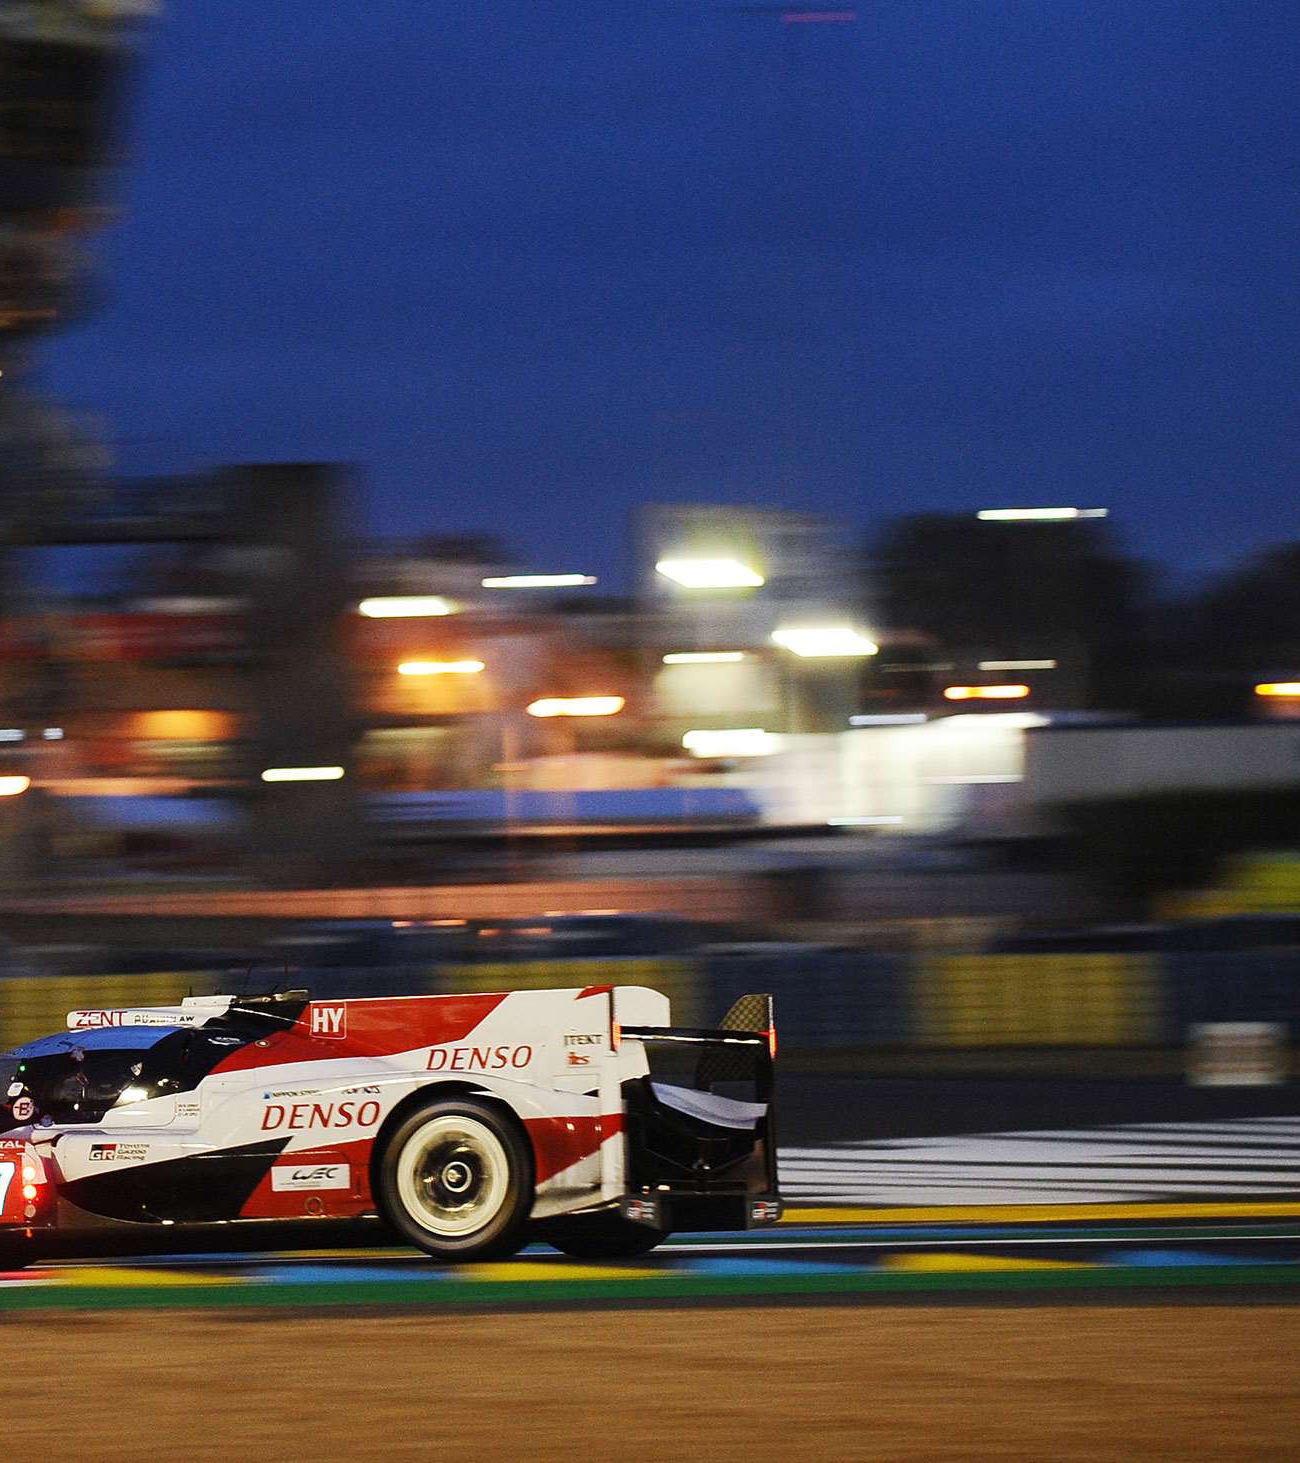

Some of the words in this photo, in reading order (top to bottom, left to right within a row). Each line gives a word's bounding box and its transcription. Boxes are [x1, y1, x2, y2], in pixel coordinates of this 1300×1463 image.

[76, 1010, 128, 1027] ZENT
[313, 1007, 345, 1034] HY
[426, 1045, 533, 1071] DENSO
[261, 1101, 381, 1131] DENSO
[90, 1149, 115, 1160] GR
[291, 1167, 339, 1180] WEC
